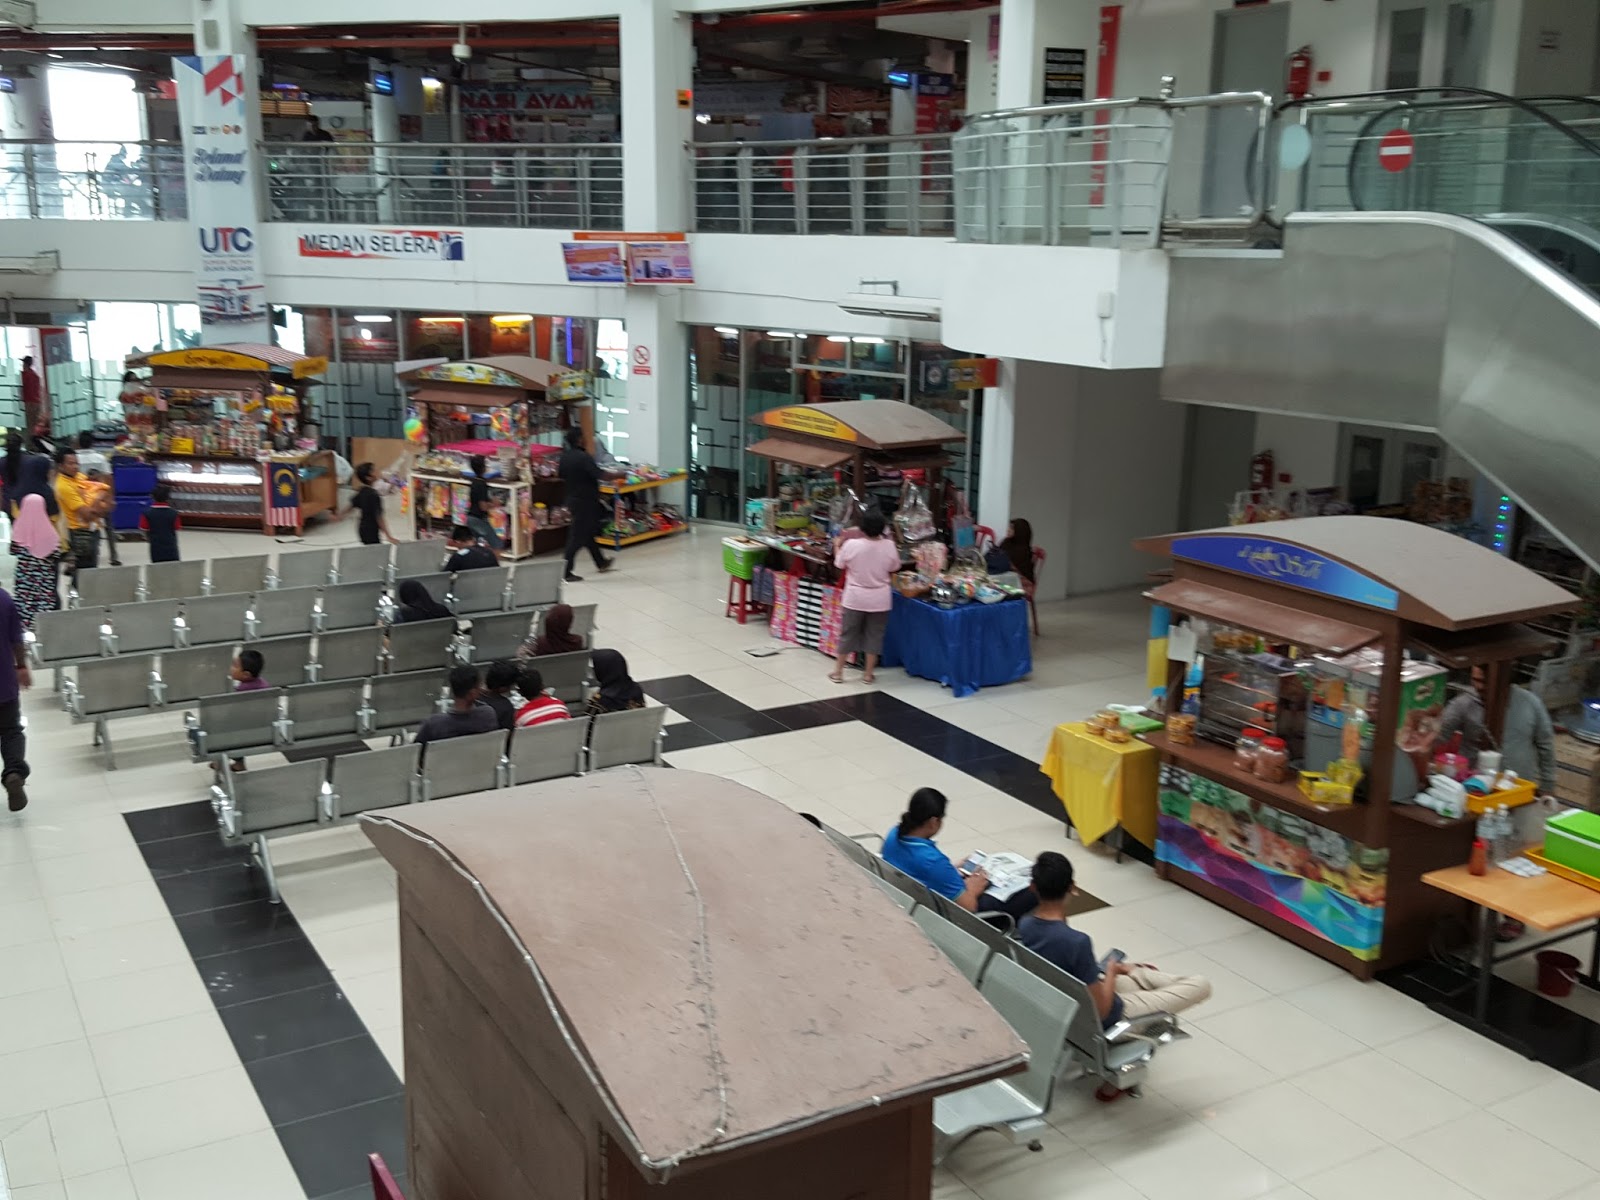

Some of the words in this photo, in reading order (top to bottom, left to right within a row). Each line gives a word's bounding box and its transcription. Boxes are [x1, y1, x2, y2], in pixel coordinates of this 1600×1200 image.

[459, 92, 517, 109] NASI
[525, 92, 594, 109] AYAM
[199, 227, 254, 253] UTC
[303, 234, 366, 251] MEDAN
[370, 235, 438, 253] SELERA
